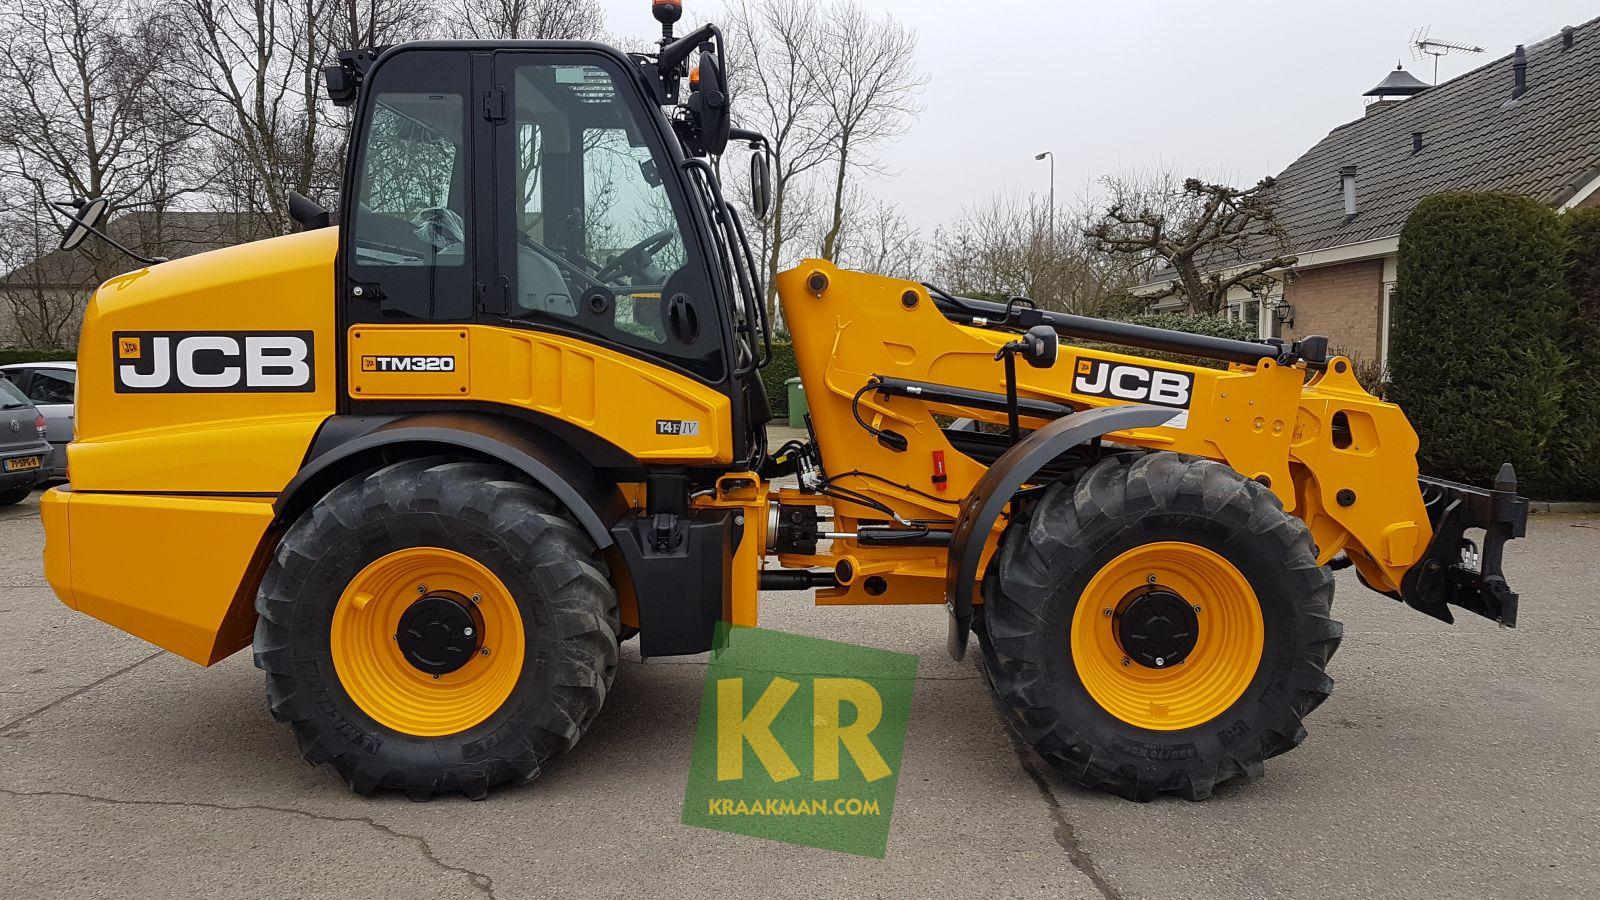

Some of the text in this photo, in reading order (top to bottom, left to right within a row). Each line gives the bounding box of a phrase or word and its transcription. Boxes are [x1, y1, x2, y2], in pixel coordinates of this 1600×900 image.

[119, 336, 310, 388] JCB
[376, 357, 455, 371] TM320
[1075, 362, 1190, 405] JCB
